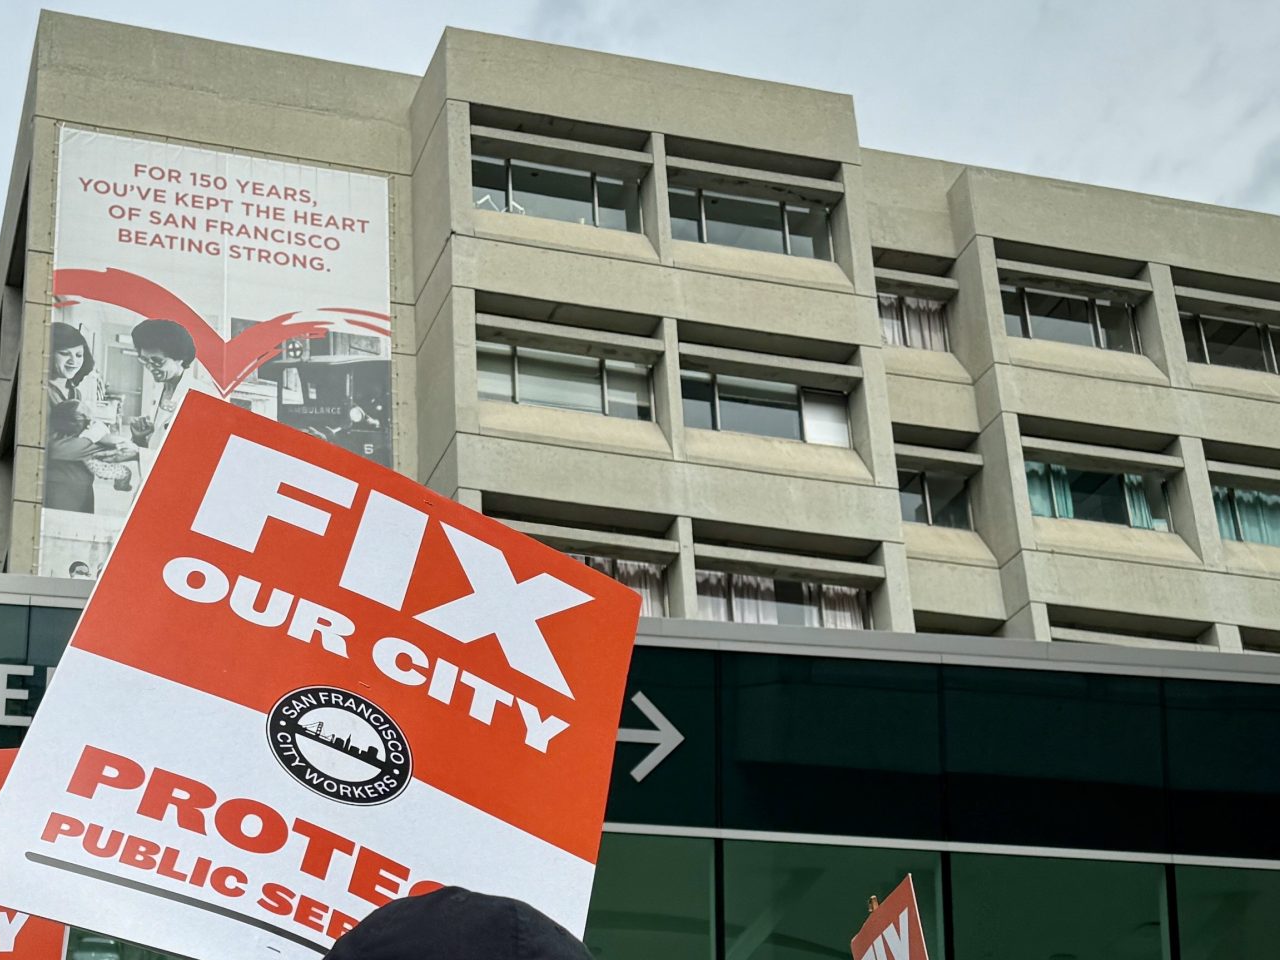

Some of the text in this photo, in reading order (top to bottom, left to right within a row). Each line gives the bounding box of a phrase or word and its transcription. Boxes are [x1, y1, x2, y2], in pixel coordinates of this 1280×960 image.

[78, 177, 369, 234] YOU'VE KEPT THE HEART
[134, 163, 317, 208] FOR 150 YEARS,
[108, 204, 340, 251] OF SAN FRANCISCO
[118, 228, 331, 272] BEATING STRONG.
[190, 435, 596, 700] FIX
[163, 557, 570, 754] OUR CITY
[282, 692, 404, 764] SAN FRANCISCO
[277, 733, 397, 798] CITY WORKERS
[40, 812, 249, 897] PUBLIC
[66, 745, 446, 906] PROTE
